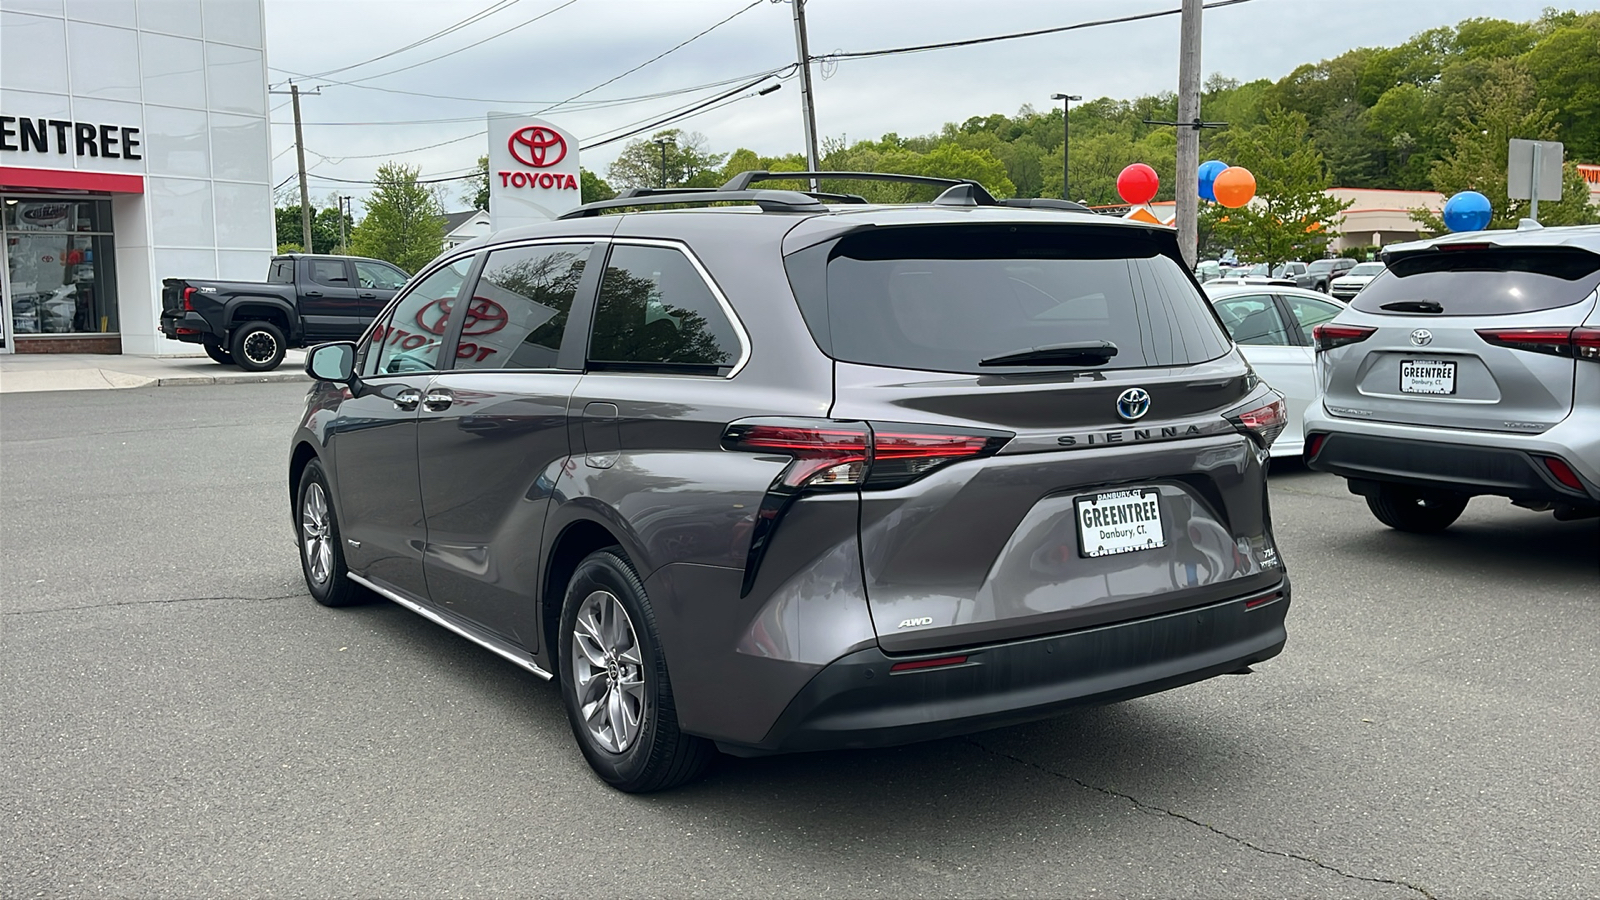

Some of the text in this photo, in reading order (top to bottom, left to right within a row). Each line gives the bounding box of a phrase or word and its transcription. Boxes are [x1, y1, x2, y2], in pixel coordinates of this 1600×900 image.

[0, 116, 142, 160] ENTREE
[498, 171, 578, 190] TOYOTA
[1404, 367, 1452, 378] GREENTREE
[1057, 425, 1200, 446] SIENNA
[1083, 501, 1157, 528] GREENTREE
[1100, 525, 1147, 539] Danbury, CT.
[898, 616, 934, 629] AWD
